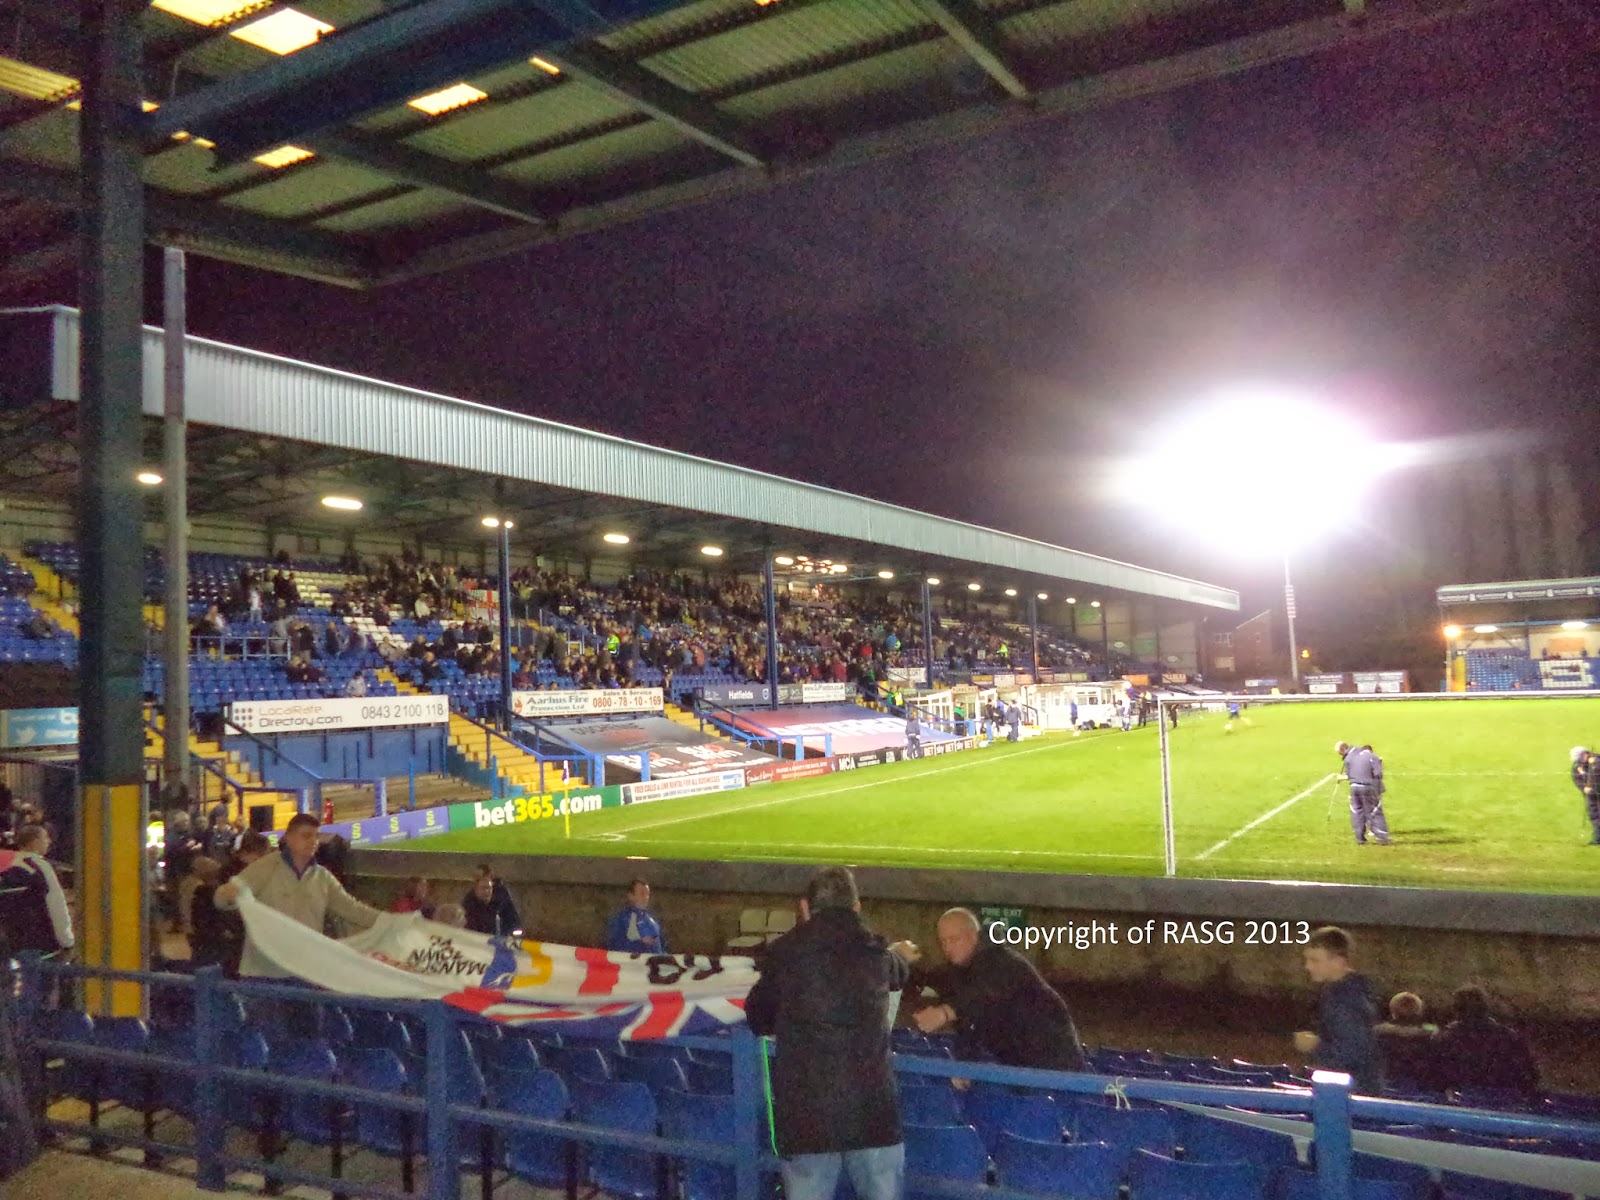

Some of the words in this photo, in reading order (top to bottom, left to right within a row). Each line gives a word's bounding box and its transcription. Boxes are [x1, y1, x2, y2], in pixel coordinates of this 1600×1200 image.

[569, 694, 589, 703] Fire
[728, 690, 754, 700] Hatfields
[593, 697, 612, 708] 0800
[619, 697, 628, 707] 78
[635, 696, 643, 706] 10
[649, 696, 662, 706] 169
[259, 704, 322, 716] LocalRate
[361, 705, 390, 720] 0843
[426, 703, 444, 716] 118
[530, 704, 571, 712] Protection
[572, 703, 585, 711] Ltd
[259, 715, 343, 728] Directory.com
[945, 743, 955, 753] BET
[964, 739, 973, 749] BET
[839, 756, 856, 771] MCA
[634, 785, 644, 794] FREE
[474, 794, 602, 828] bet365.com
[981, 907, 1001, 917] FIRE
[1003, 908, 1022, 917] EXIT
